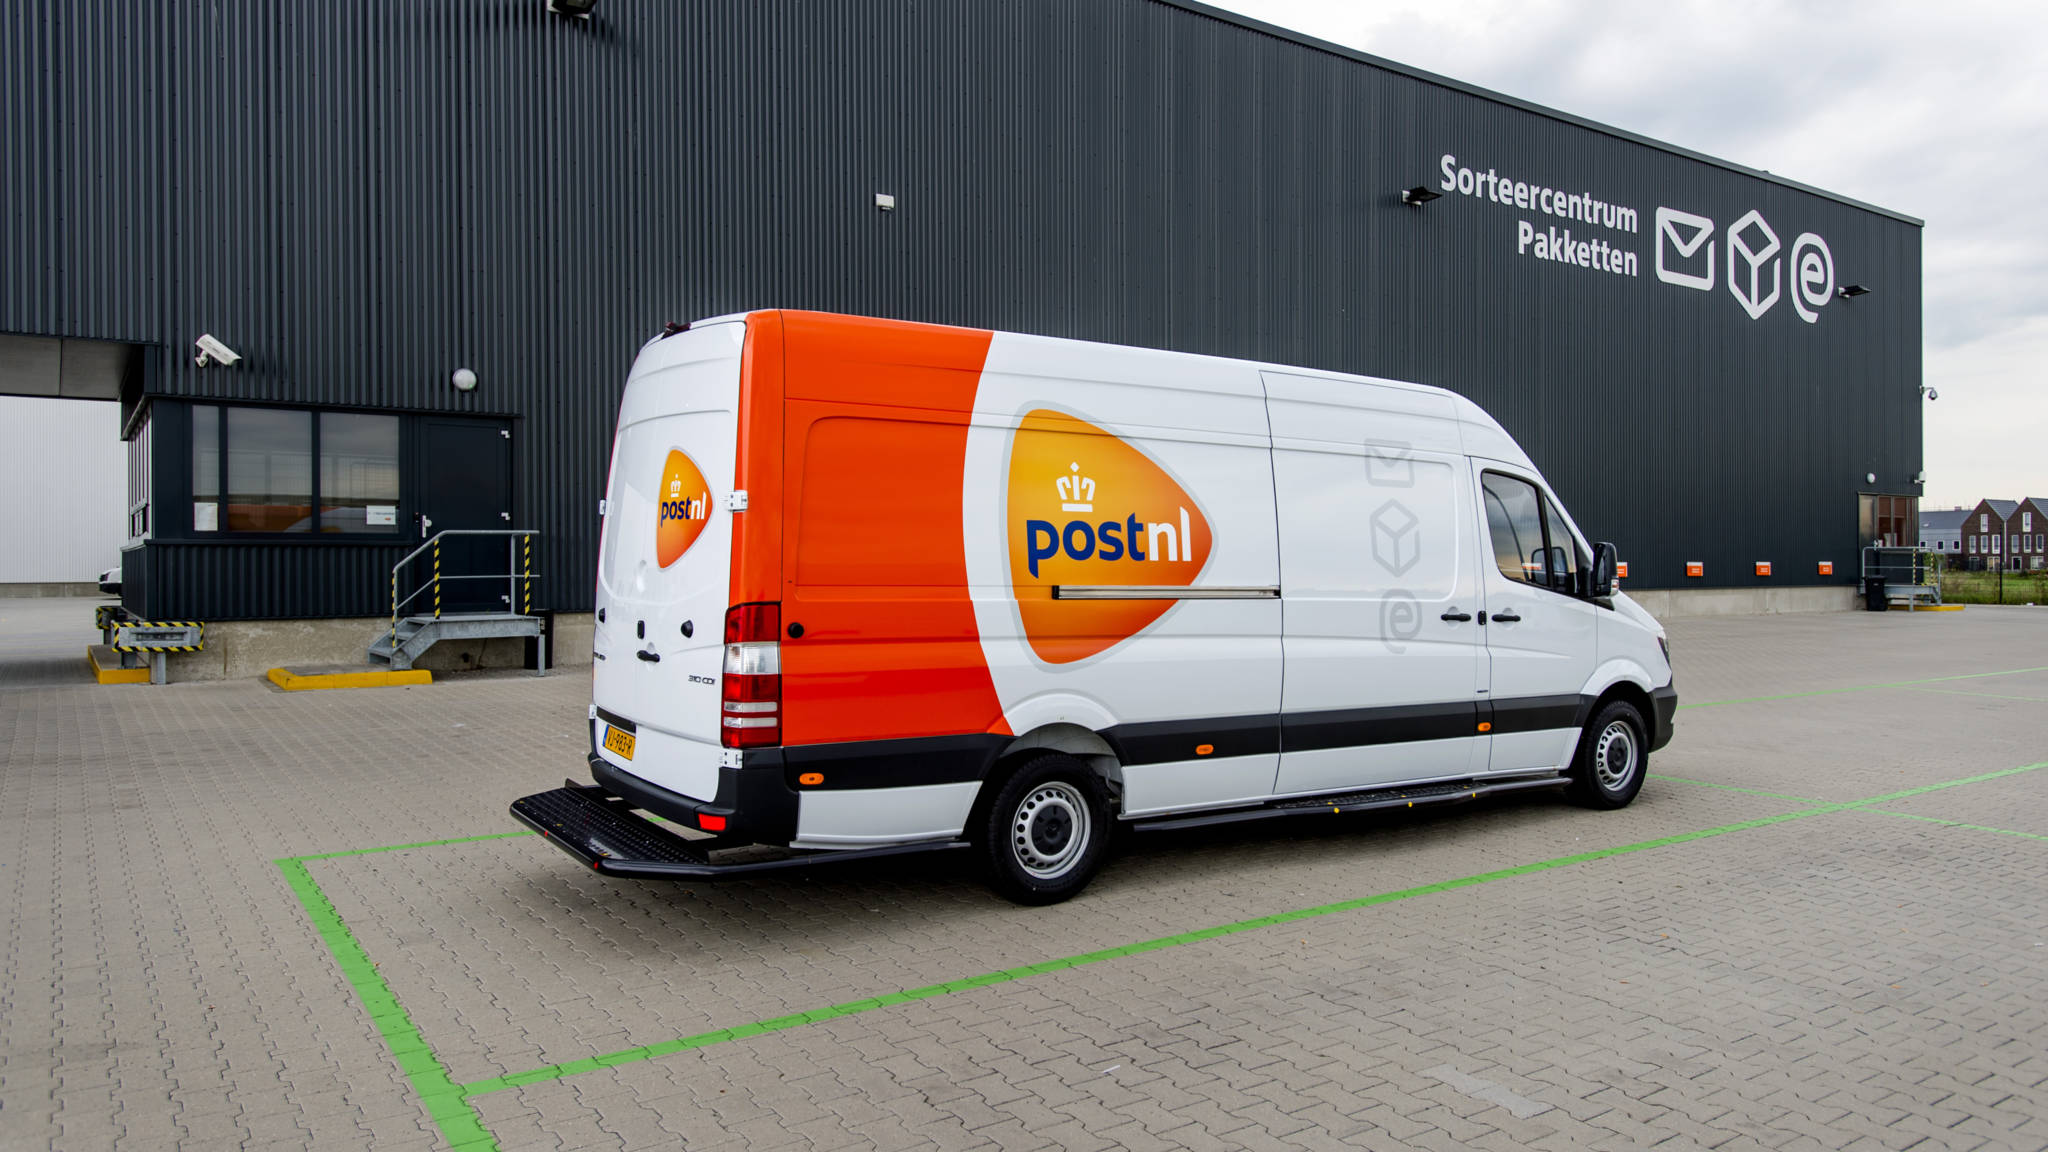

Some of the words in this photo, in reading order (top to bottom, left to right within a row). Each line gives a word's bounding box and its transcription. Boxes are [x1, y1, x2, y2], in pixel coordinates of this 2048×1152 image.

[1440, 154, 1638, 233] Sorteercentrum
[1518, 220, 1638, 277] Pakketten
[660, 491, 706, 528] postnl
[1026, 506, 1192, 579] postnl
